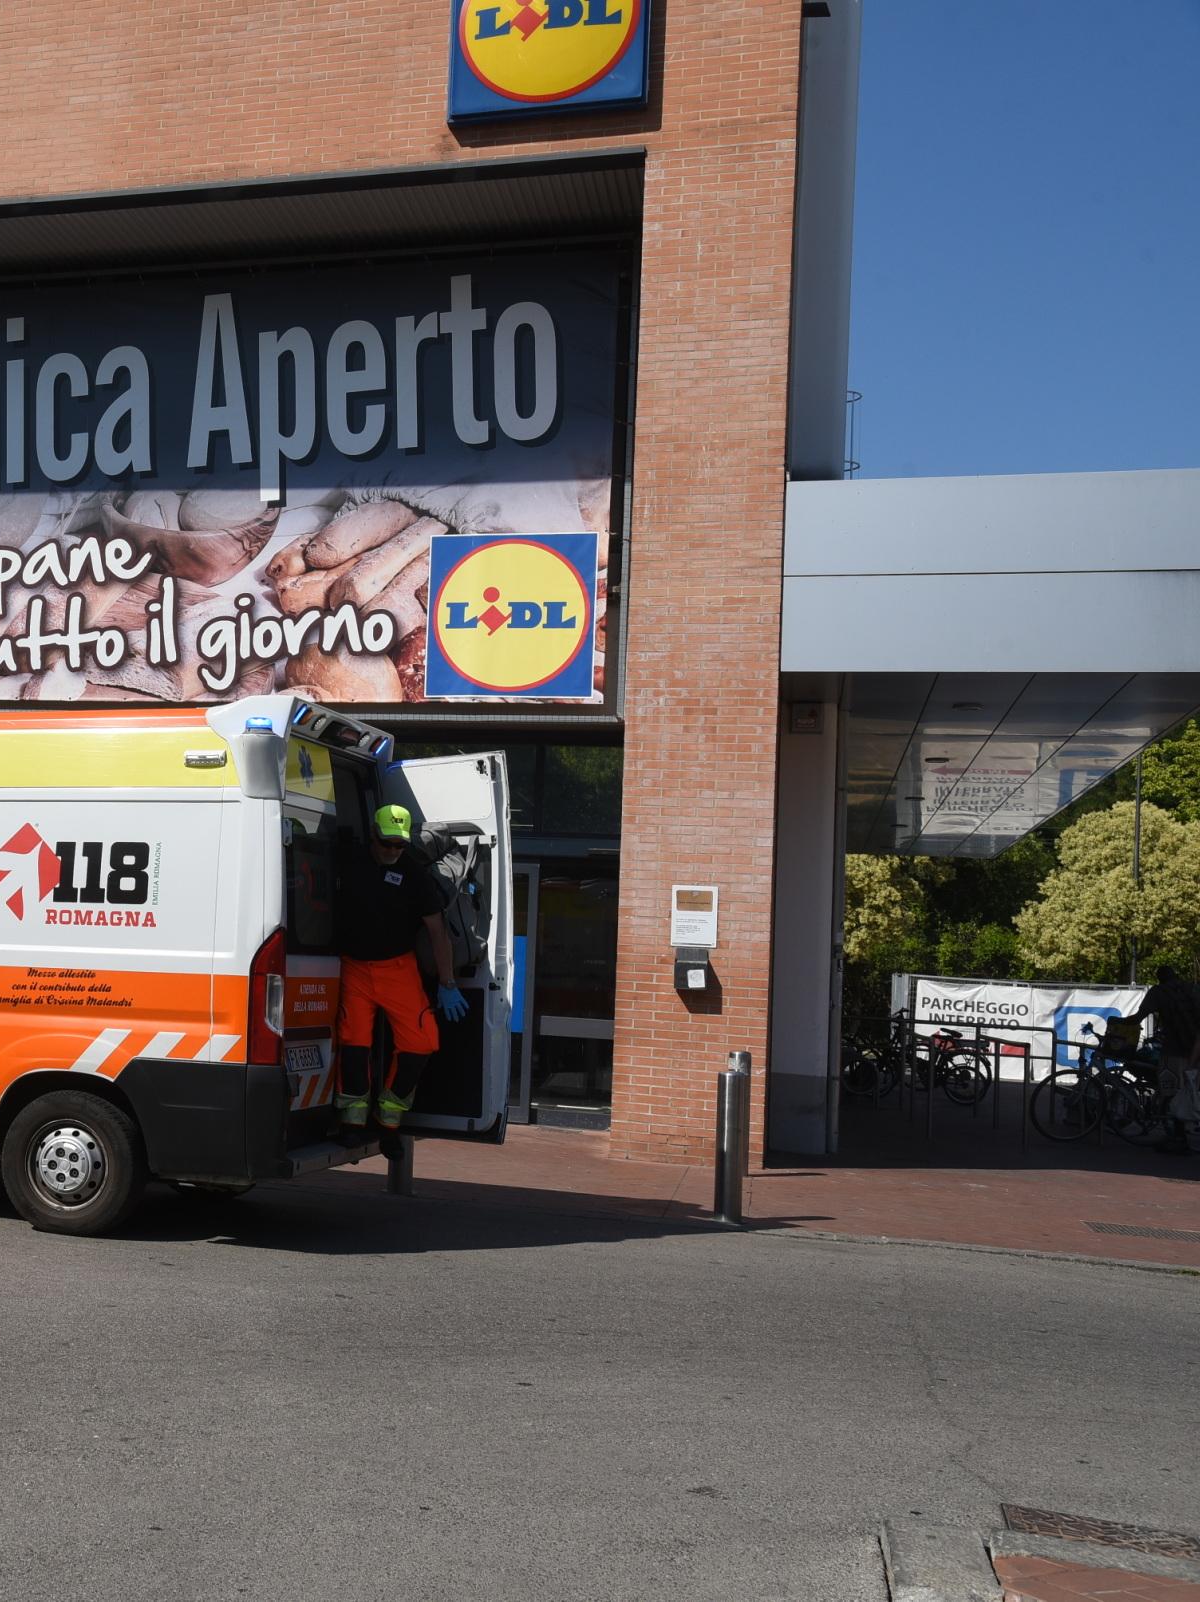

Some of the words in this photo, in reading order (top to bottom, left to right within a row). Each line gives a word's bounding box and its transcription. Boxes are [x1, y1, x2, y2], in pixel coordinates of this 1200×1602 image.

[187, 274, 558, 502] Aperto
[149, 576, 177, 665] il
[200, 597, 394, 688] giorno
[53, 841, 150, 905] 118
[45, 908, 157, 928] ROMAGNA
[58, 968, 97, 979] allestito
[11, 983, 26, 991] con
[27, 981, 38, 991] il
[38, 982, 86, 993] contributo
[87, 983, 112, 993] della
[34, 995, 44, 1005] di
[86, 995, 134, 1007] Malandri
[921, 996, 1029, 1017] PARCHEGGIO
